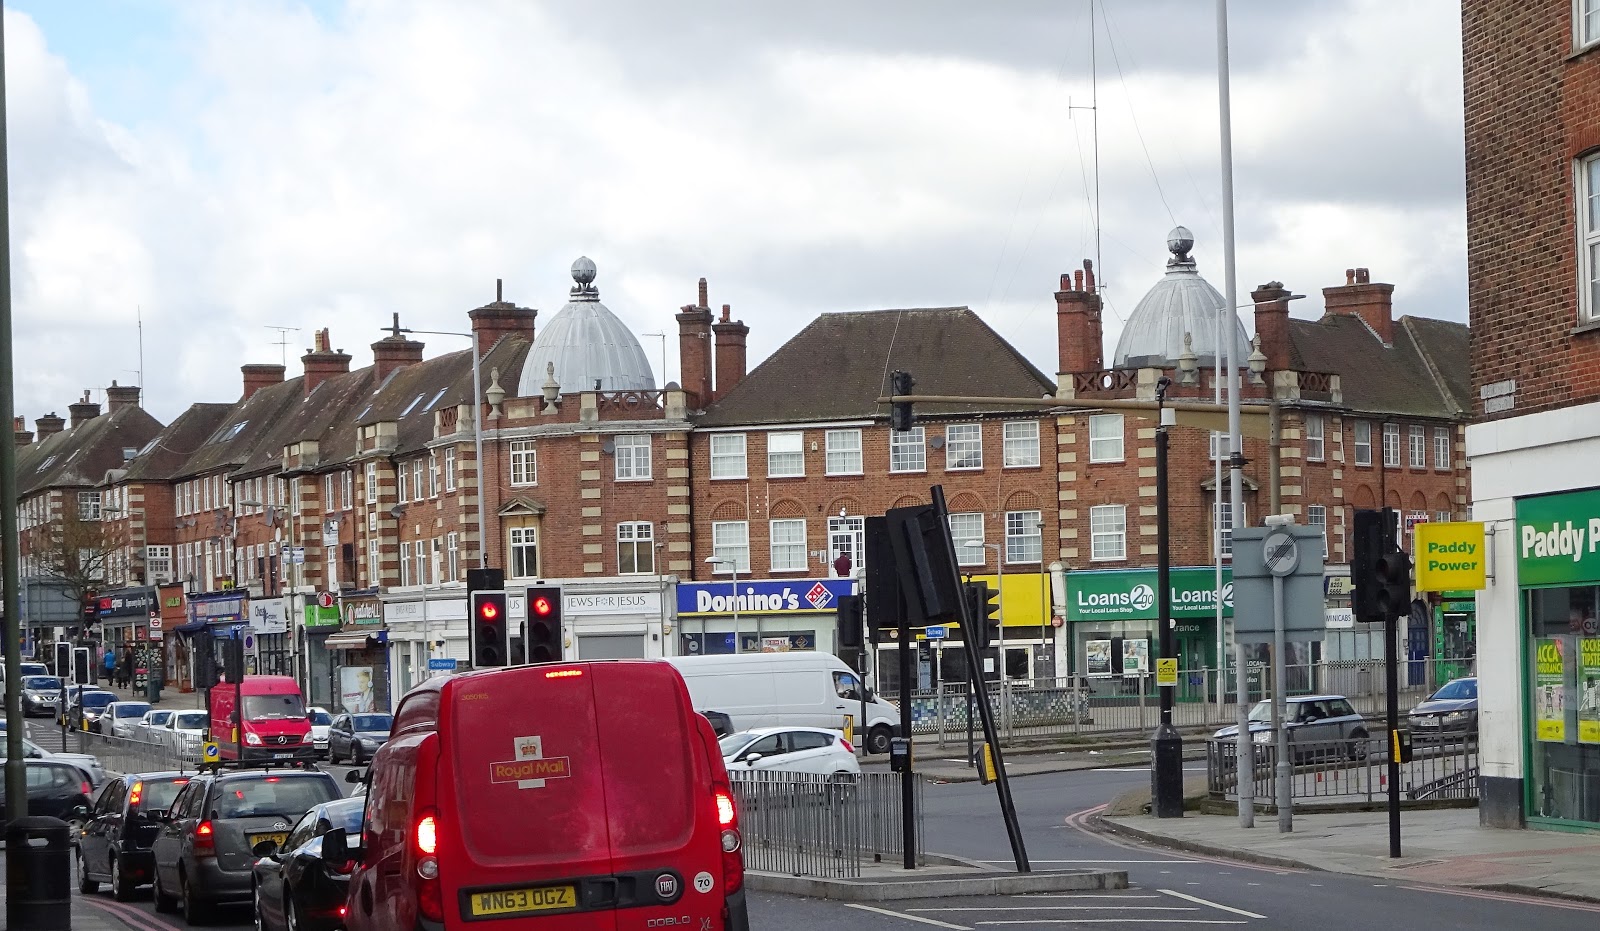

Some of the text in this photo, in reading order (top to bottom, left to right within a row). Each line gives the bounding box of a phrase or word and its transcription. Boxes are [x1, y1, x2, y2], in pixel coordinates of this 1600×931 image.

[1428, 541, 1476, 554] Paddy
[1522, 520, 1585, 562] Paddy
[1428, 560, 1478, 571] Power
[566, 597, 593, 609] JEWS
[616, 596, 646, 609] JESUS
[696, 587, 800, 612] Domino's
[1326, 614, 1352, 622] MINICABS
[927, 628, 943, 636] Subway
[1580, 639, 1600, 653] POCKE
[1537, 645, 1559, 662] ACCA
[1581, 652, 1600, 667] TIPSTE
[430, 661, 455, 669] Subway
[496, 761, 564, 778] Royal Mail
[660, 881, 673, 892] FIAT
[698, 879, 710, 887] 70
[480, 889, 568, 911] WN63 OGZ
[647, 916, 714, 931] DOBLO XL
